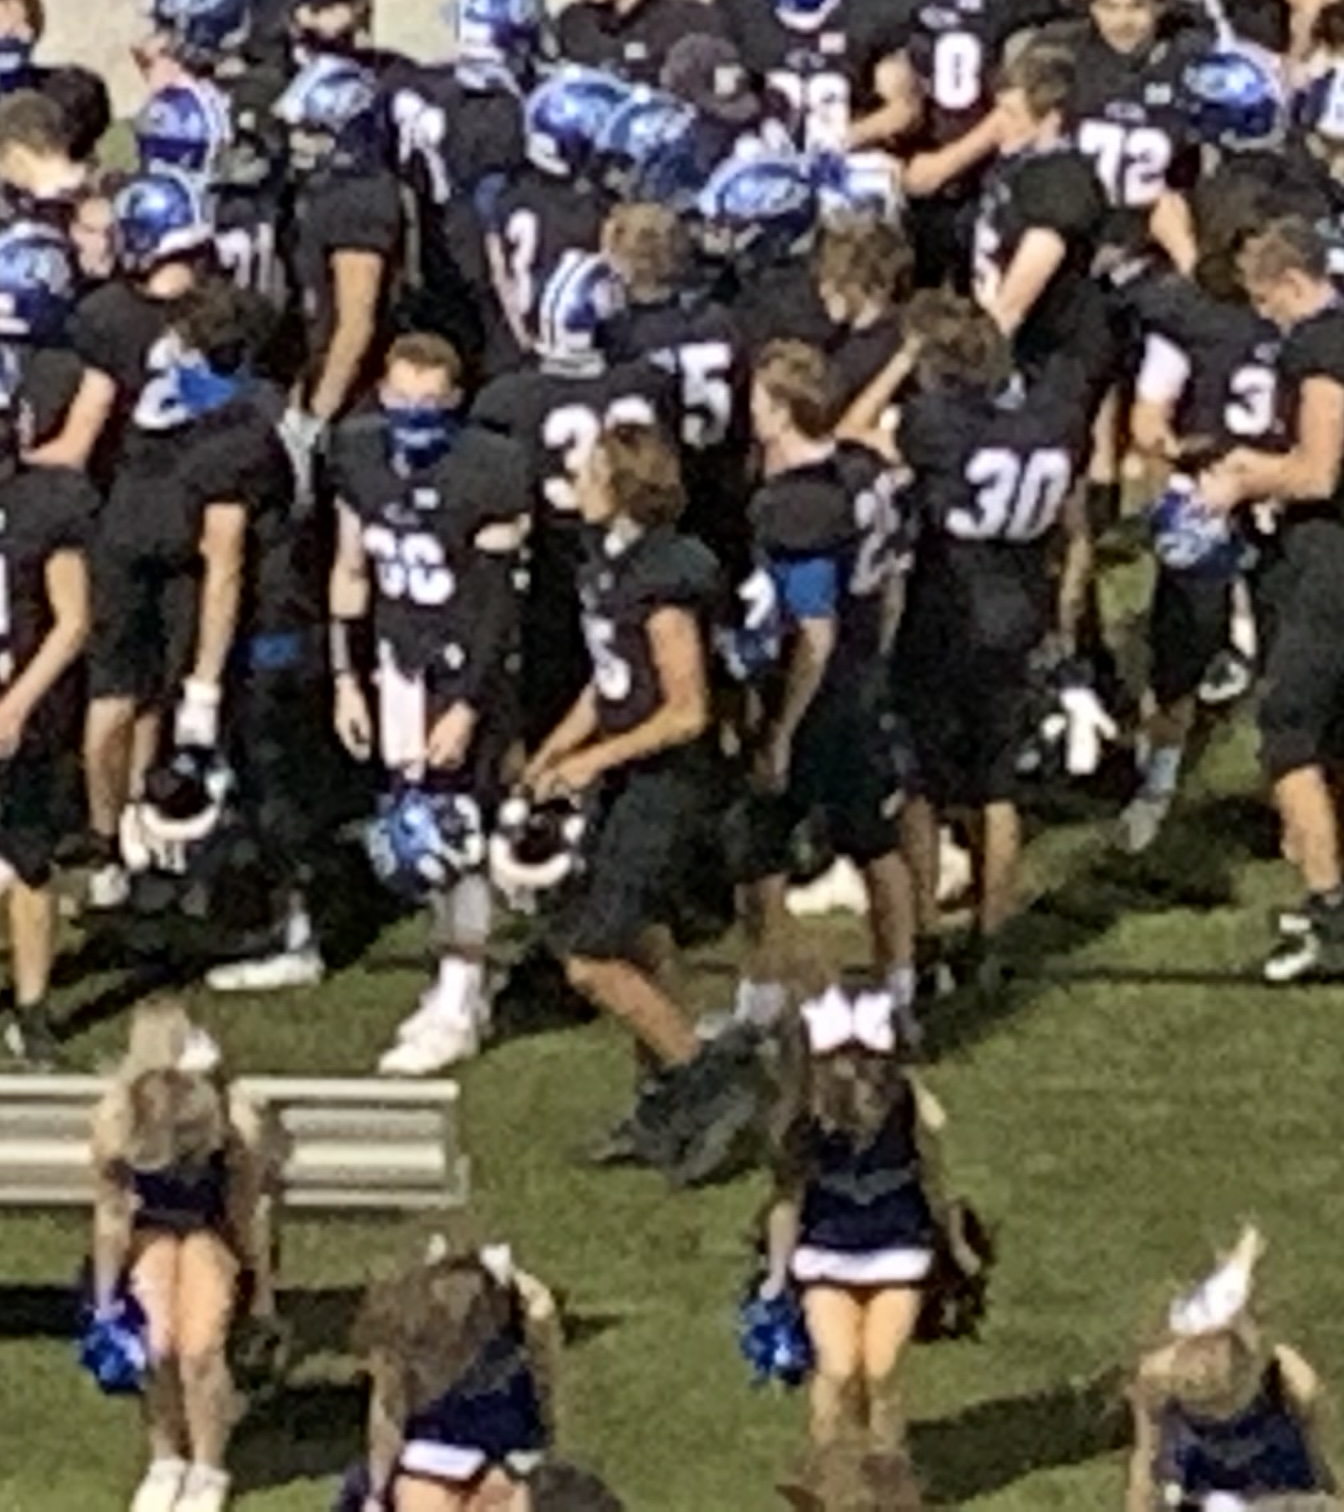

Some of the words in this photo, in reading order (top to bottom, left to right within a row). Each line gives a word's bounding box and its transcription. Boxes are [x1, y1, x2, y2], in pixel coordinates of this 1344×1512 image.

[1079, 119, 1171, 206] 72
[1224, 364, 1277, 435] 3
[542, 396, 655, 511] 3
[945, 446, 1072, 541] 30
